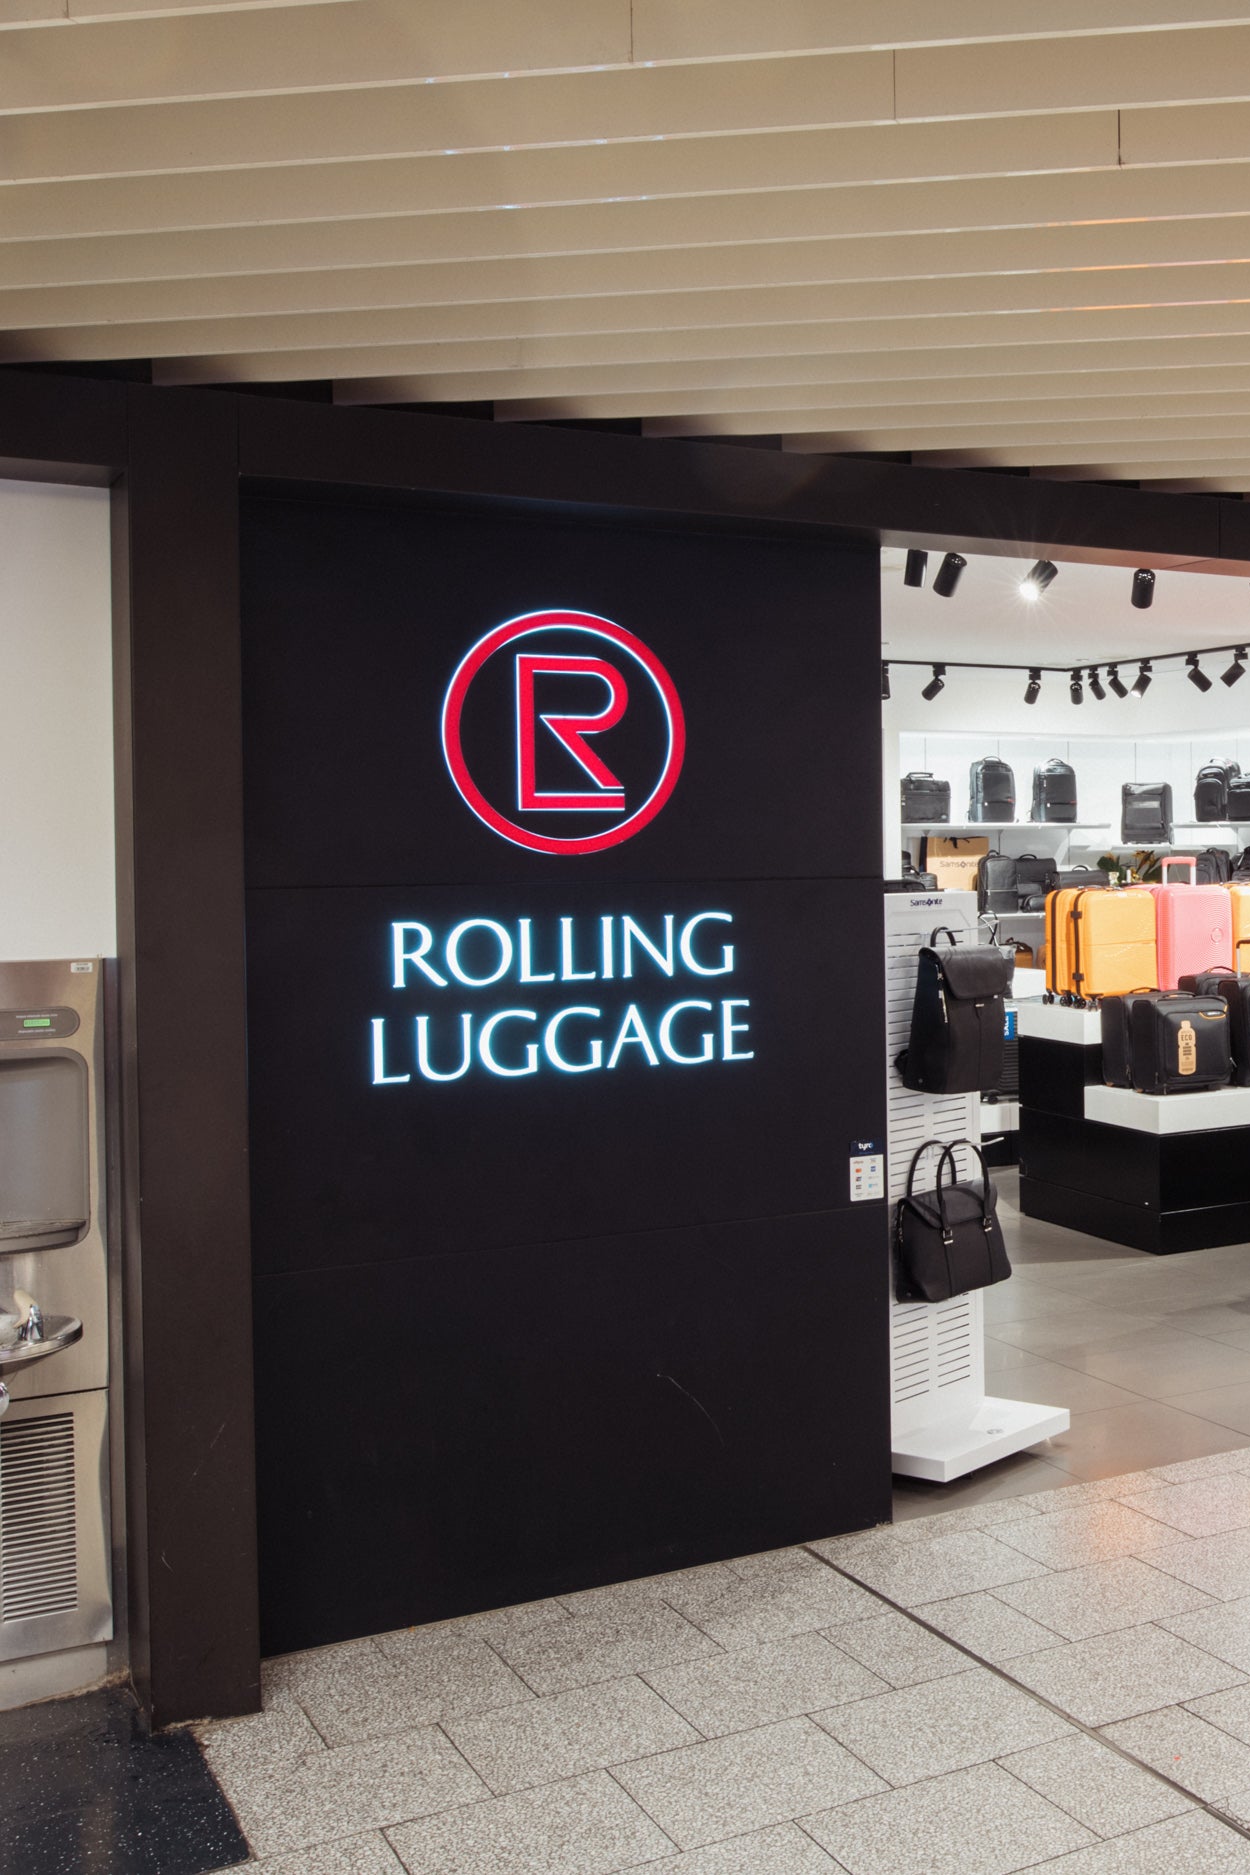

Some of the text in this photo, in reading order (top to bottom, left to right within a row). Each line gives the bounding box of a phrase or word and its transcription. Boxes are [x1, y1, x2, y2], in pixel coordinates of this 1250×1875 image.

[909, 898, 943, 907] Samsonite
[390, 911, 736, 989] ROLLING
[369, 998, 756, 1086] LUGGAGE
